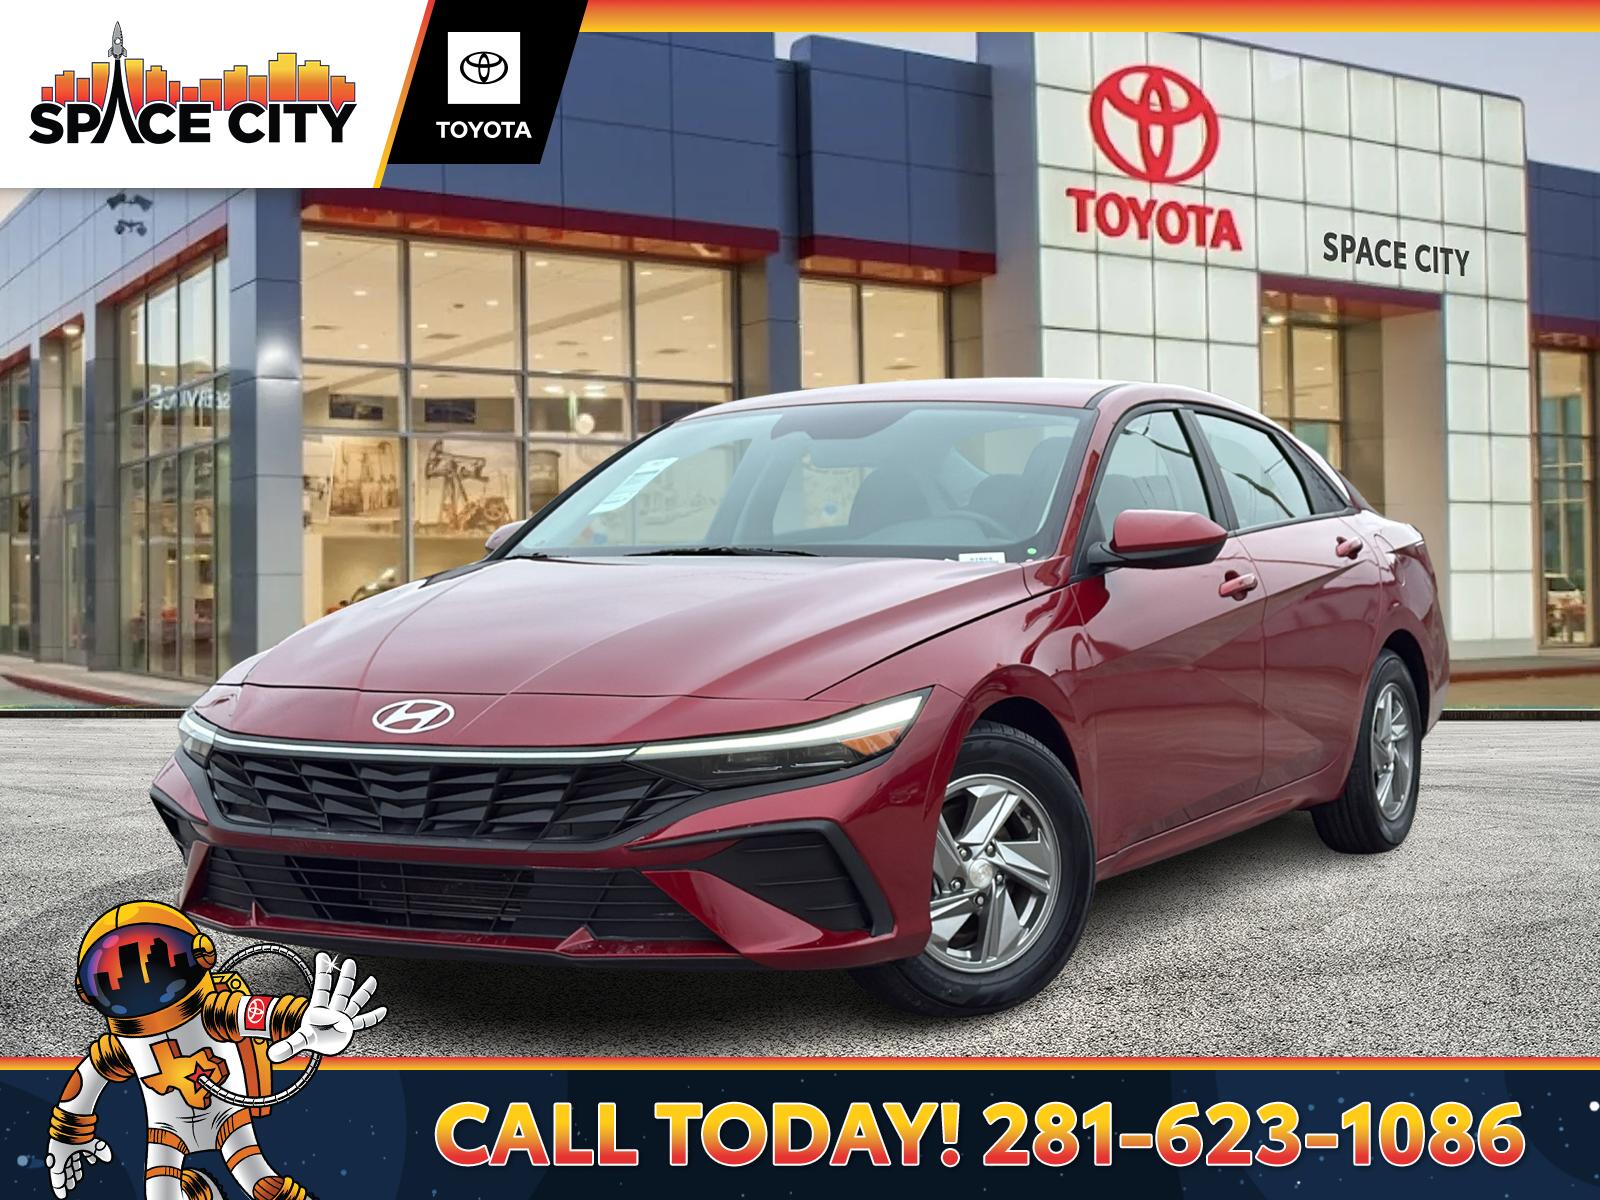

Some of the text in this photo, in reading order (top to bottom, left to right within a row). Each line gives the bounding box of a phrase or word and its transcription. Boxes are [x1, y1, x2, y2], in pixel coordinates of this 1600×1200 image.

[1065, 187, 1243, 251] TOYOTA
[1323, 232, 1470, 277] SPACE CITY
